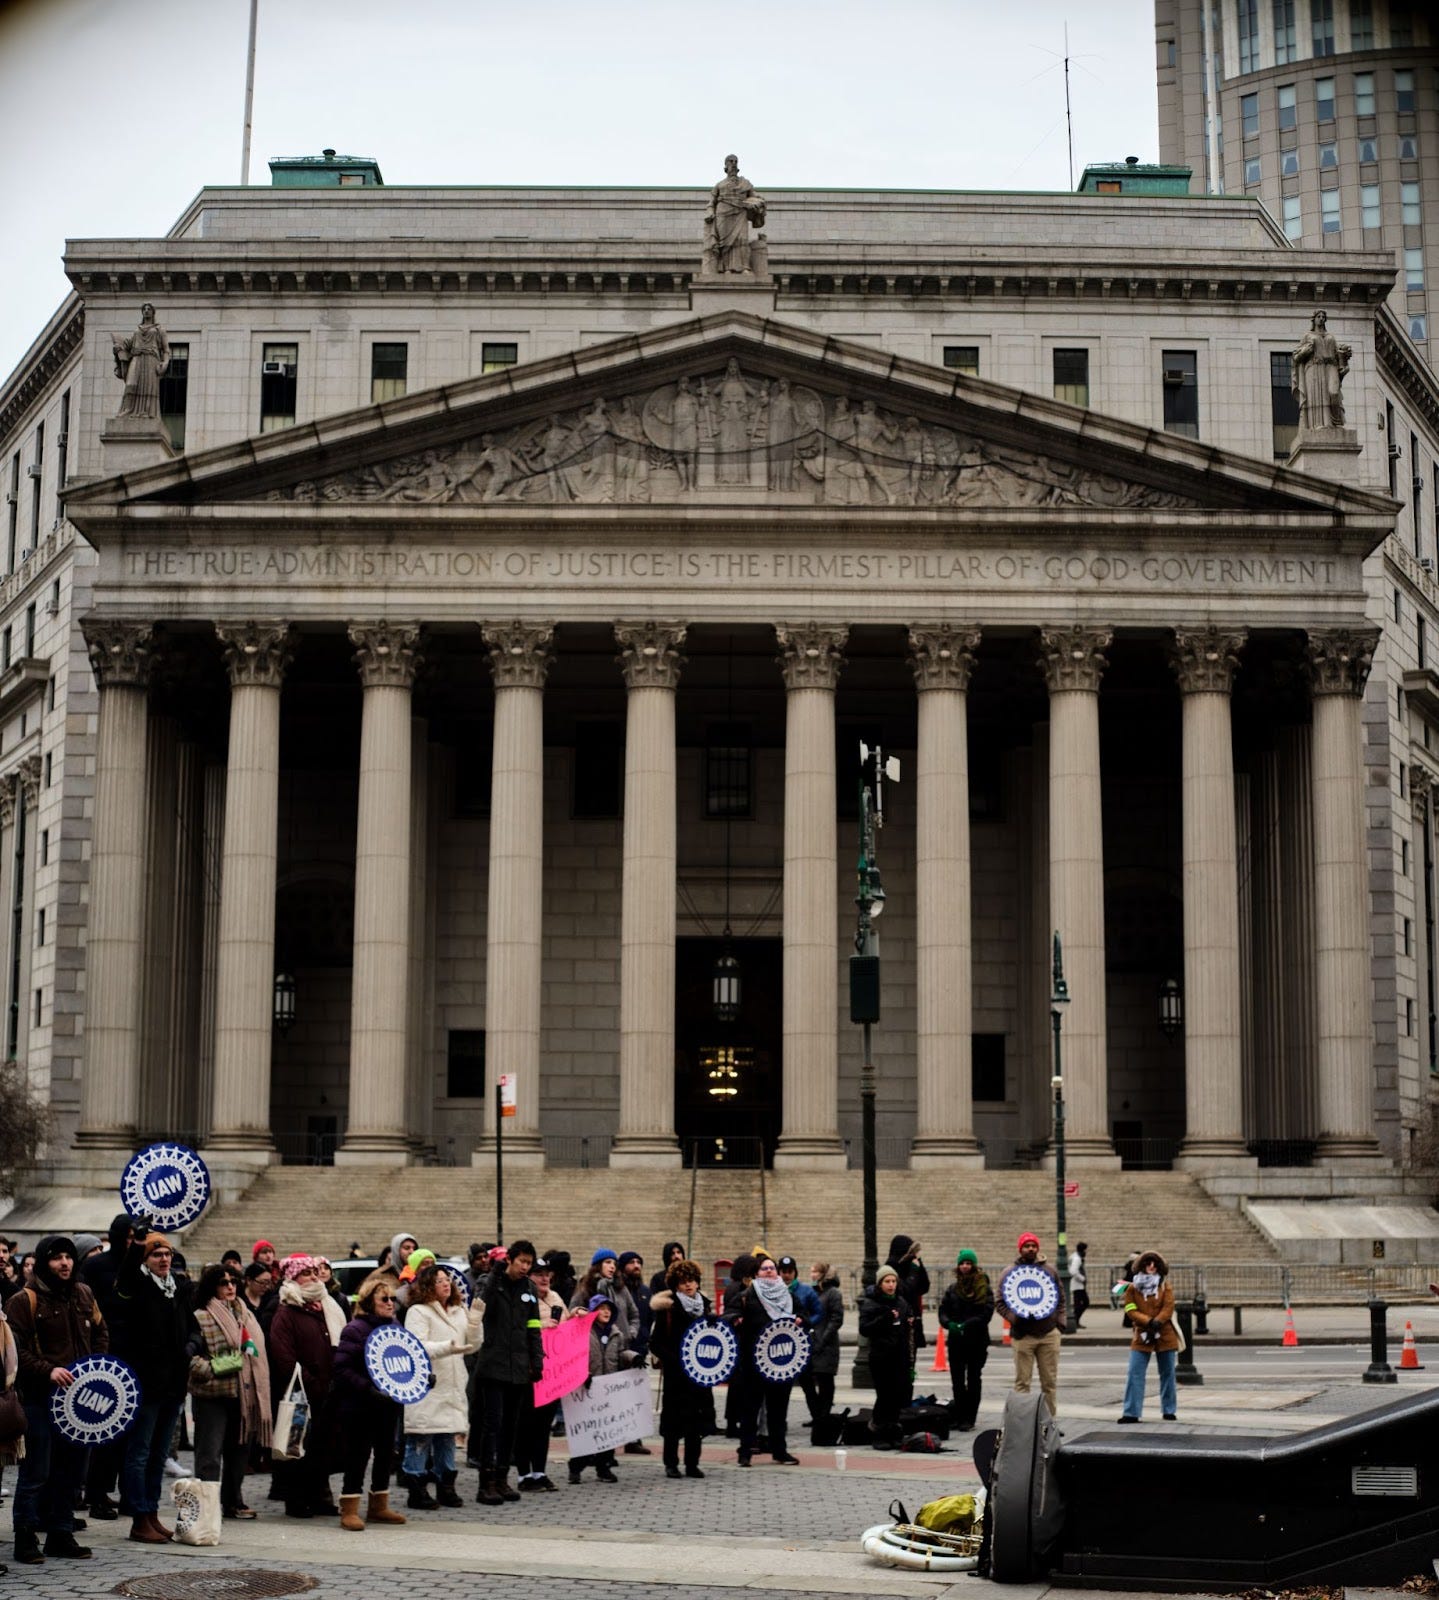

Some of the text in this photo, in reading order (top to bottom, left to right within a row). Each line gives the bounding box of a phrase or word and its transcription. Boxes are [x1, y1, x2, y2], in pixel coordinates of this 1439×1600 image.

[128, 551, 1336, 584] THE TRUE ADMINISTRATION OF JUSTICE IS THE FIRMEST PILLAR OF GOOD GOVERNMENT
[145, 1172, 182, 1201] UAW
[1018, 1287, 1042, 1299] UAW
[698, 1344, 721, 1359] UAW
[769, 1342, 793, 1359] UAW
[384, 1355, 411, 1374] UAW
[604, 1380, 630, 1396] STAND
[77, 1387, 114, 1415] UAW
[591, 1402, 609, 1413] FOR
[569, 1402, 644, 1437] IMMIGRANT
[593, 1420, 638, 1444] RIGHTS
